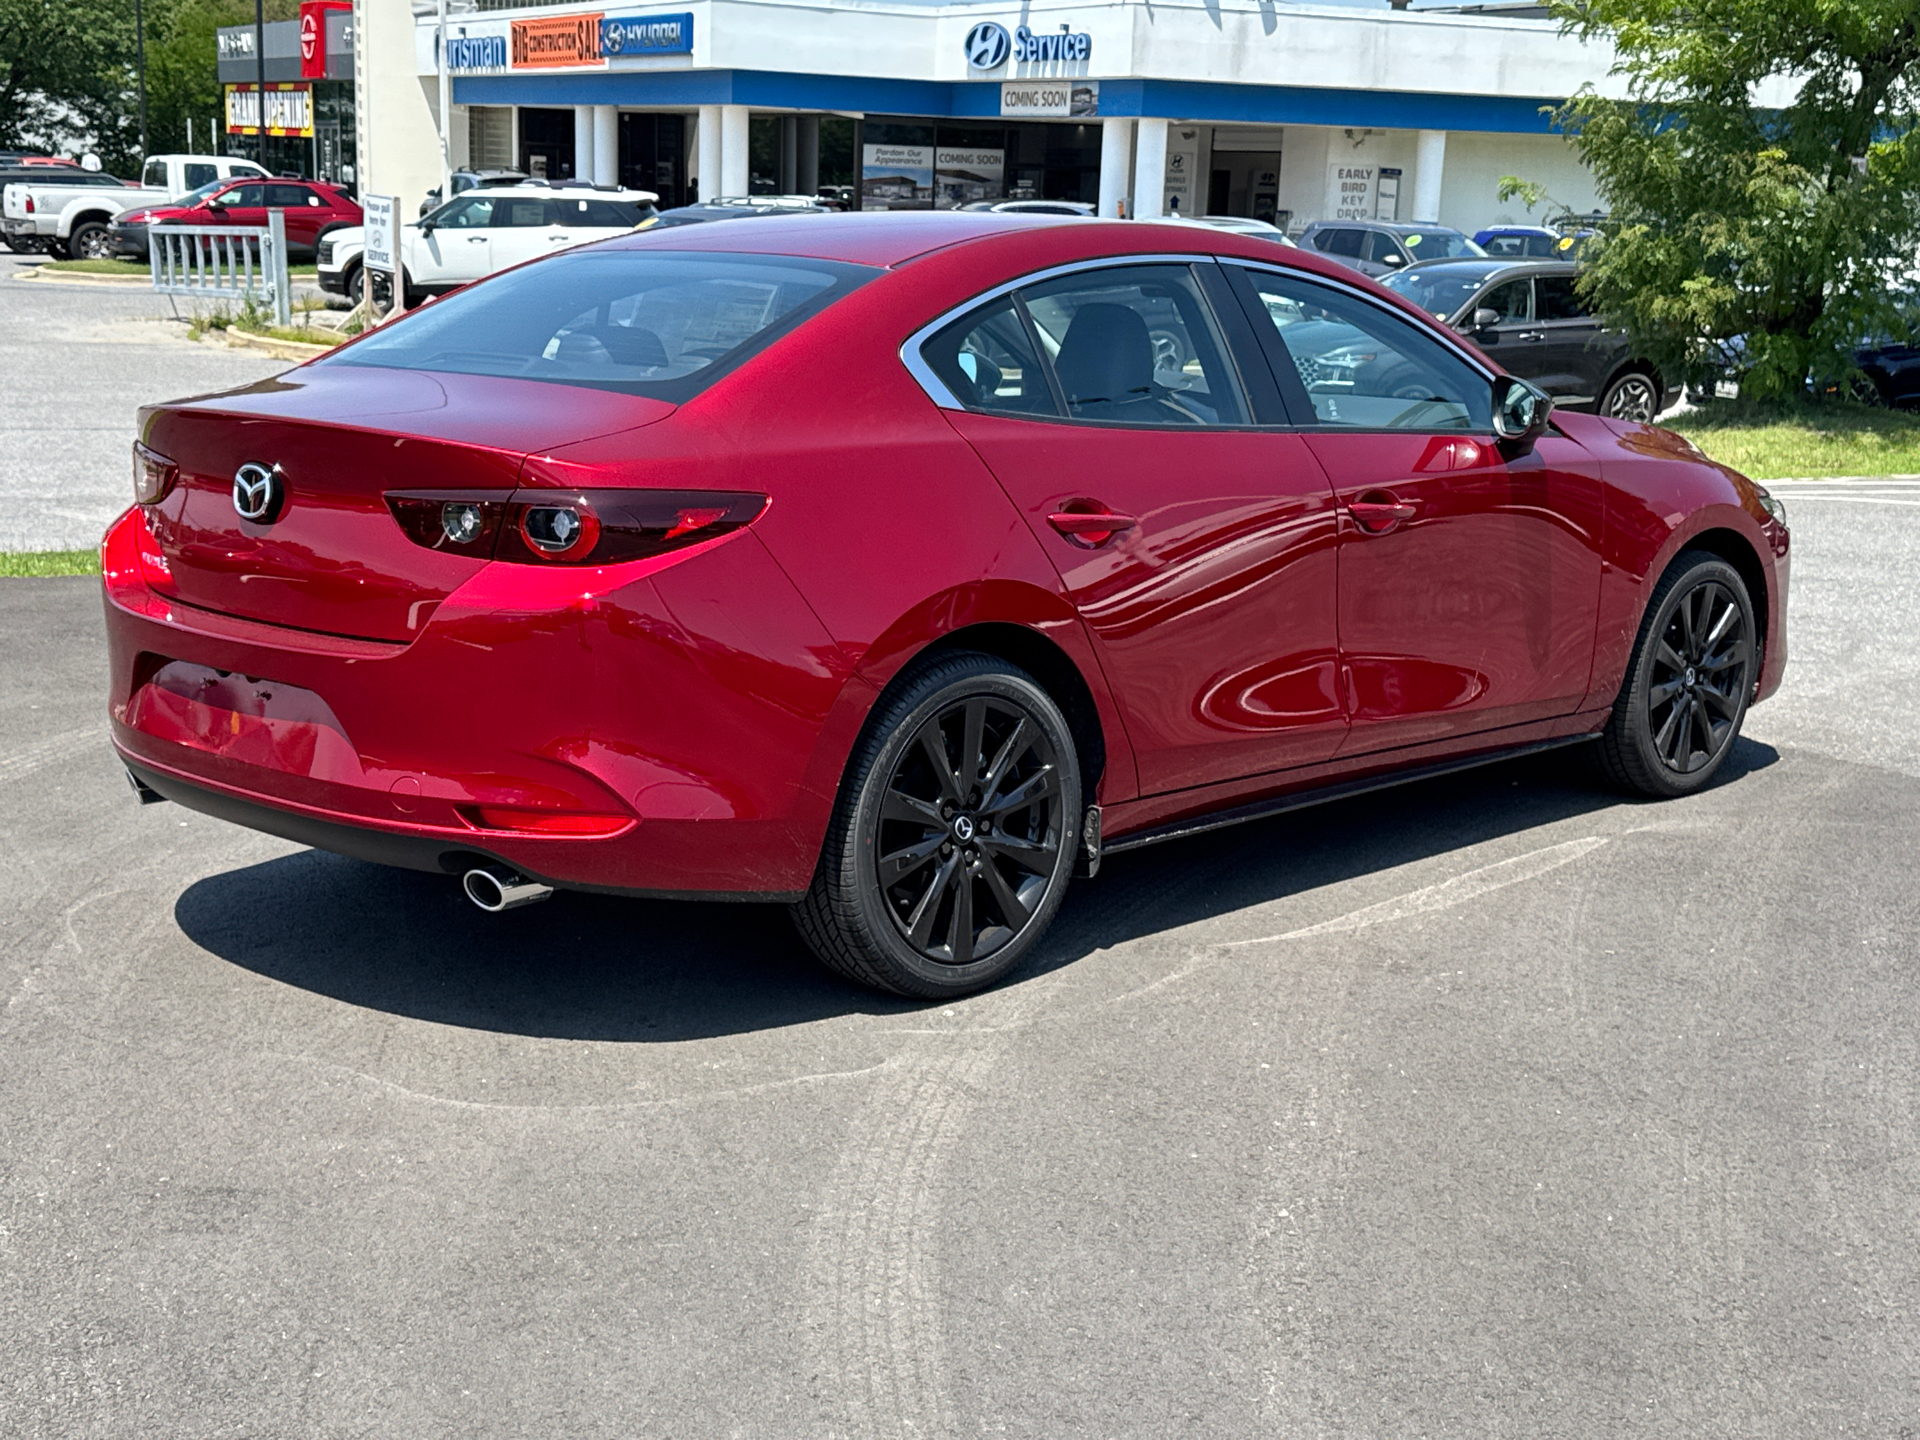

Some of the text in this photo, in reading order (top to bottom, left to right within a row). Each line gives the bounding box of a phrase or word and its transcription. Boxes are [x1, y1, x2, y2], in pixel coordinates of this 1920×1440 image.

[627, 22, 682, 47] HYUNDAI
[512, 25, 528, 64] BIG
[529, 32, 577, 53] CONSTRUCTION
[1013, 26, 1091, 62] Service
[1005, 91, 1068, 107] COMING SOON
[264, 91, 310, 129] OPENING
[876, 148, 922, 157] Pardon Our
[875, 156, 922, 165] Appearance
[938, 153, 1002, 165] COMING SOON
[1338, 168, 1373, 180] EARLY
[1341, 182, 1367, 193] BIRD
[1341, 195, 1365, 206] KEY
[1336, 208, 1368, 219] DROP
[368, 249, 390, 264] SERVICE
